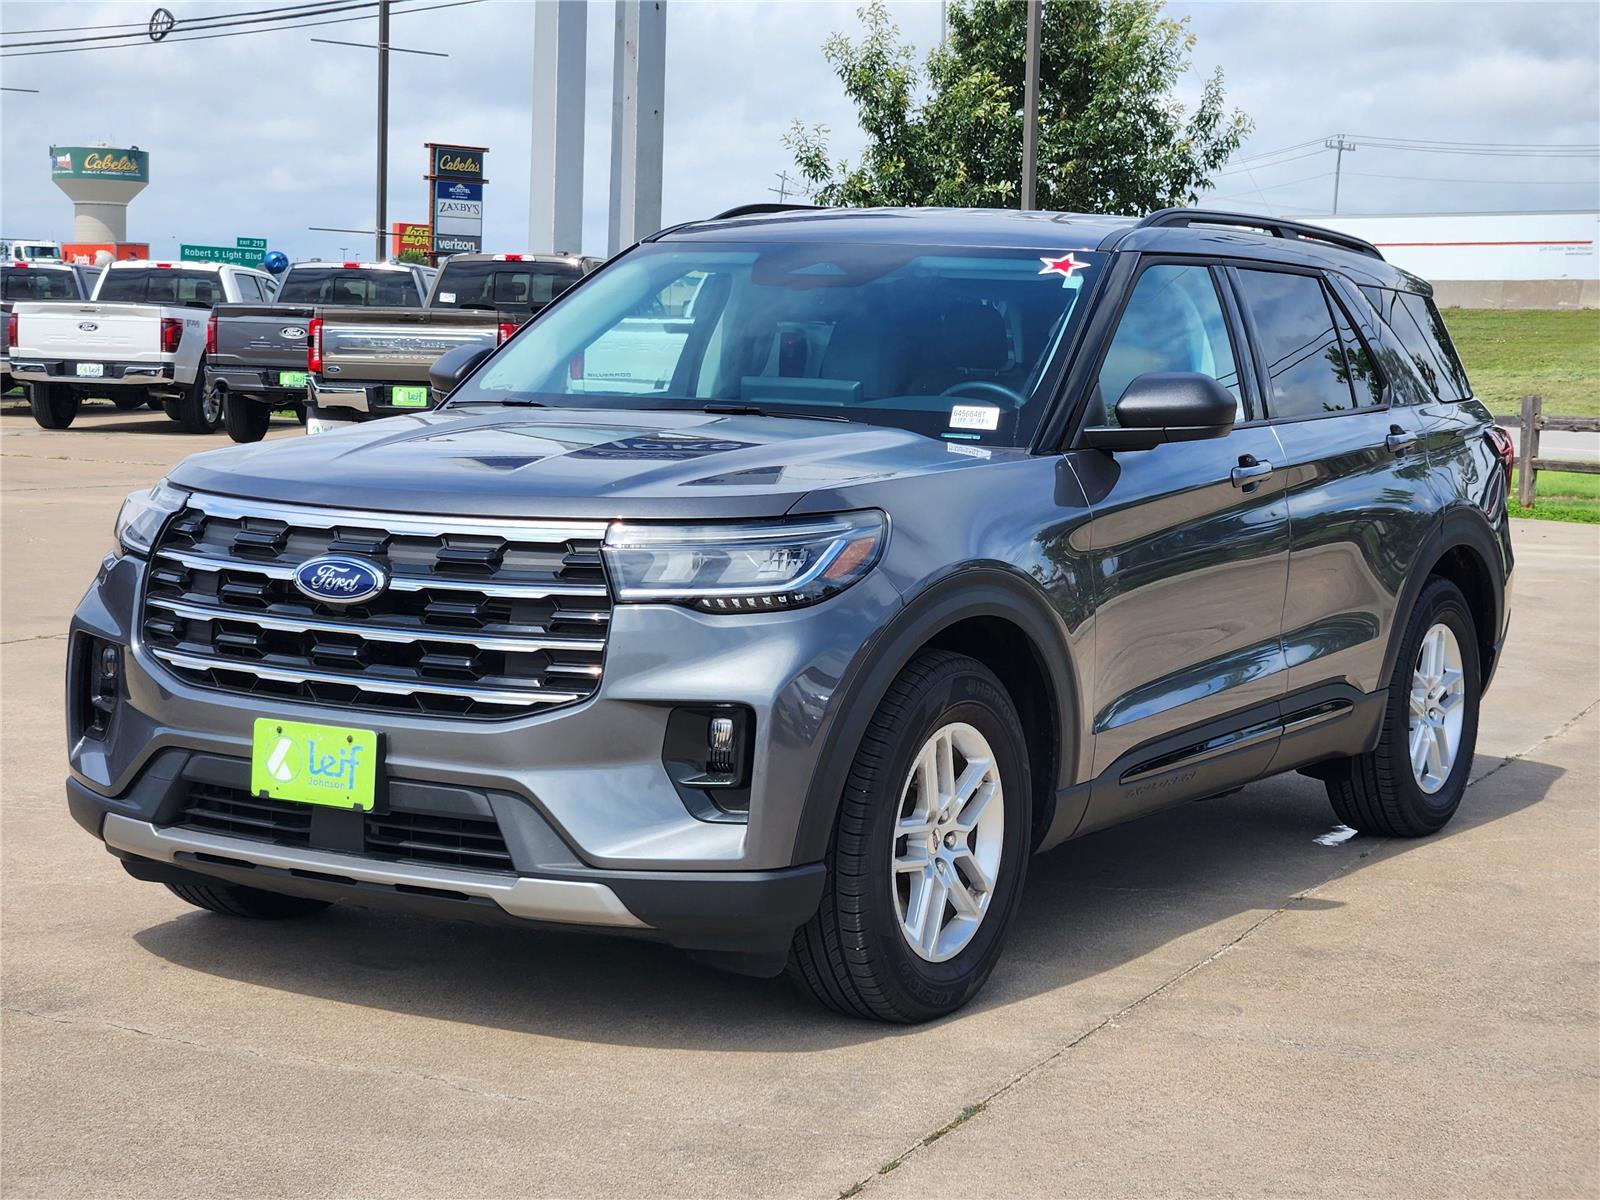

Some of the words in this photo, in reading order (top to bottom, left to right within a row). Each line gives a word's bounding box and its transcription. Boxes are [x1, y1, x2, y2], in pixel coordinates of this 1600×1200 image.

[83, 153, 138, 173] Cabela's
[440, 155, 480, 172] Cabela's
[440, 201, 480, 215] ZAXBY'S
[438, 238, 476, 251] verizon
[184, 248, 211, 257] Robert
[222, 251, 242, 260] Light
[245, 252, 262, 260] Blvd
[311, 564, 361, 592] Ford
[308, 777, 346, 790] Johnson
